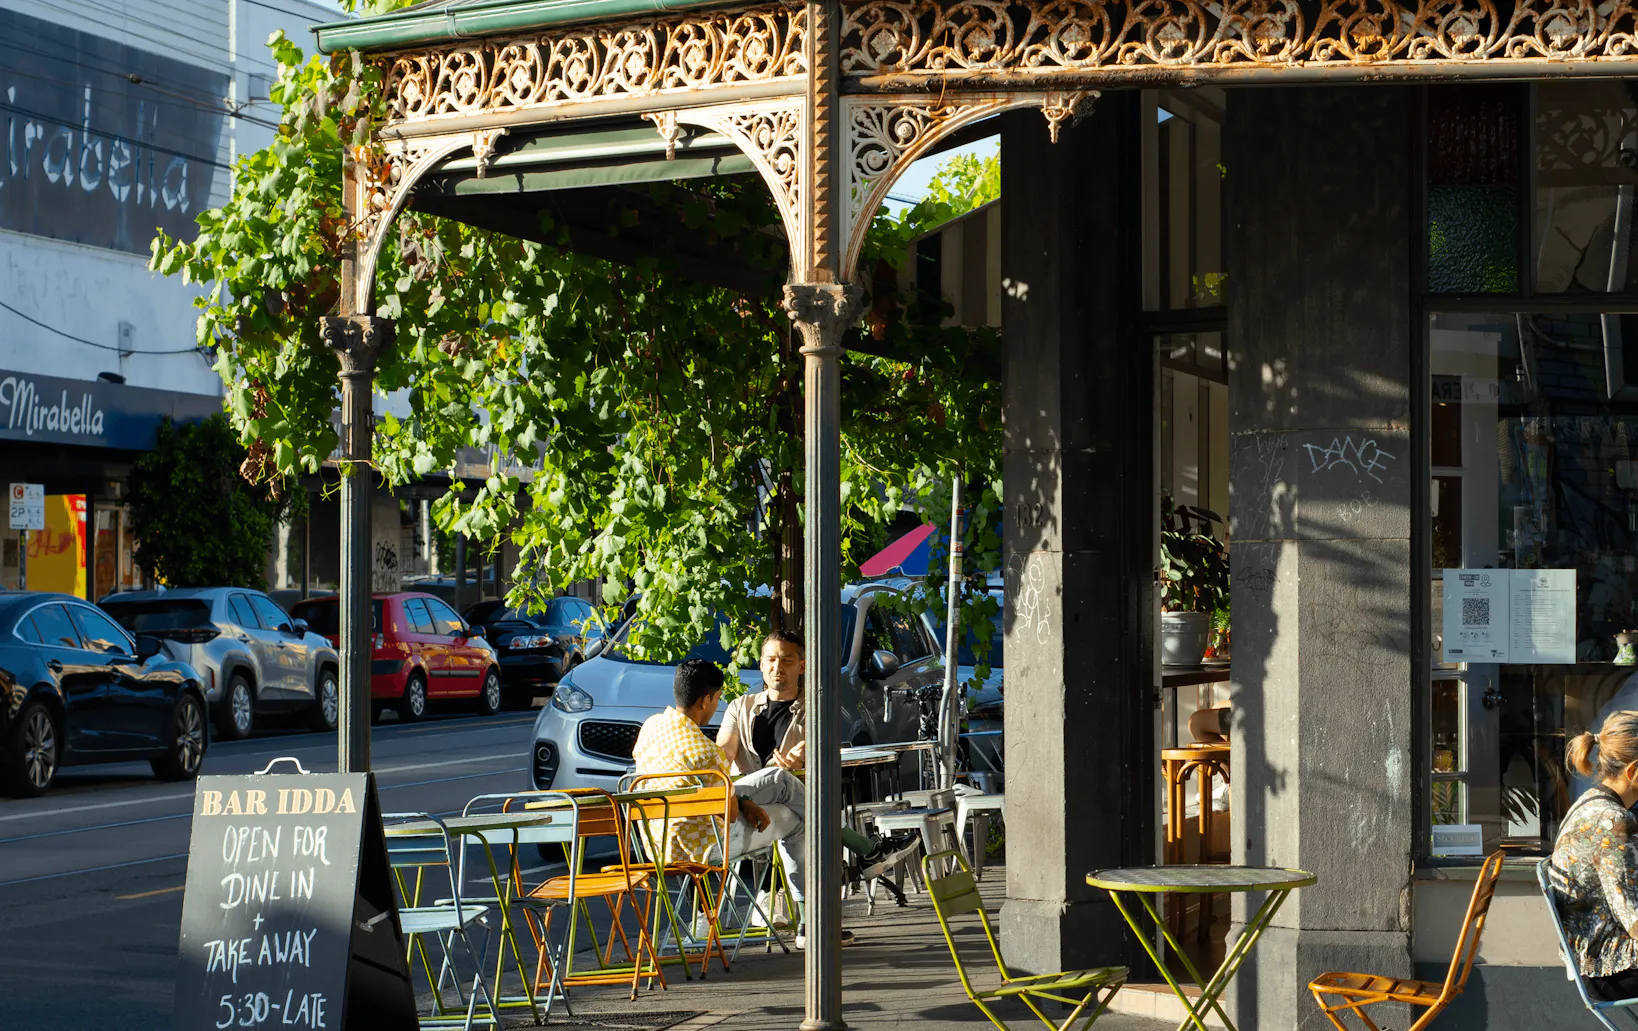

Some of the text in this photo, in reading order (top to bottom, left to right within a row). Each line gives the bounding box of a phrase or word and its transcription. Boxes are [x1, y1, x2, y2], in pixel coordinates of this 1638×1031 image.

[0, 83, 190, 214] irabella
[0, 376, 104, 436] Mirabella
[11, 507, 25, 518] 2P
[1016, 503, 1044, 528] 132
[200, 788, 357, 817] BAR IDDA
[222, 825, 330, 865] OPEN FOR
[219, 867, 315, 910] DINE IN
[253, 912, 265, 931] +
[203, 928, 317, 984] TAKE AWAY
[216, 989, 328, 1030] 5:30-LATE
